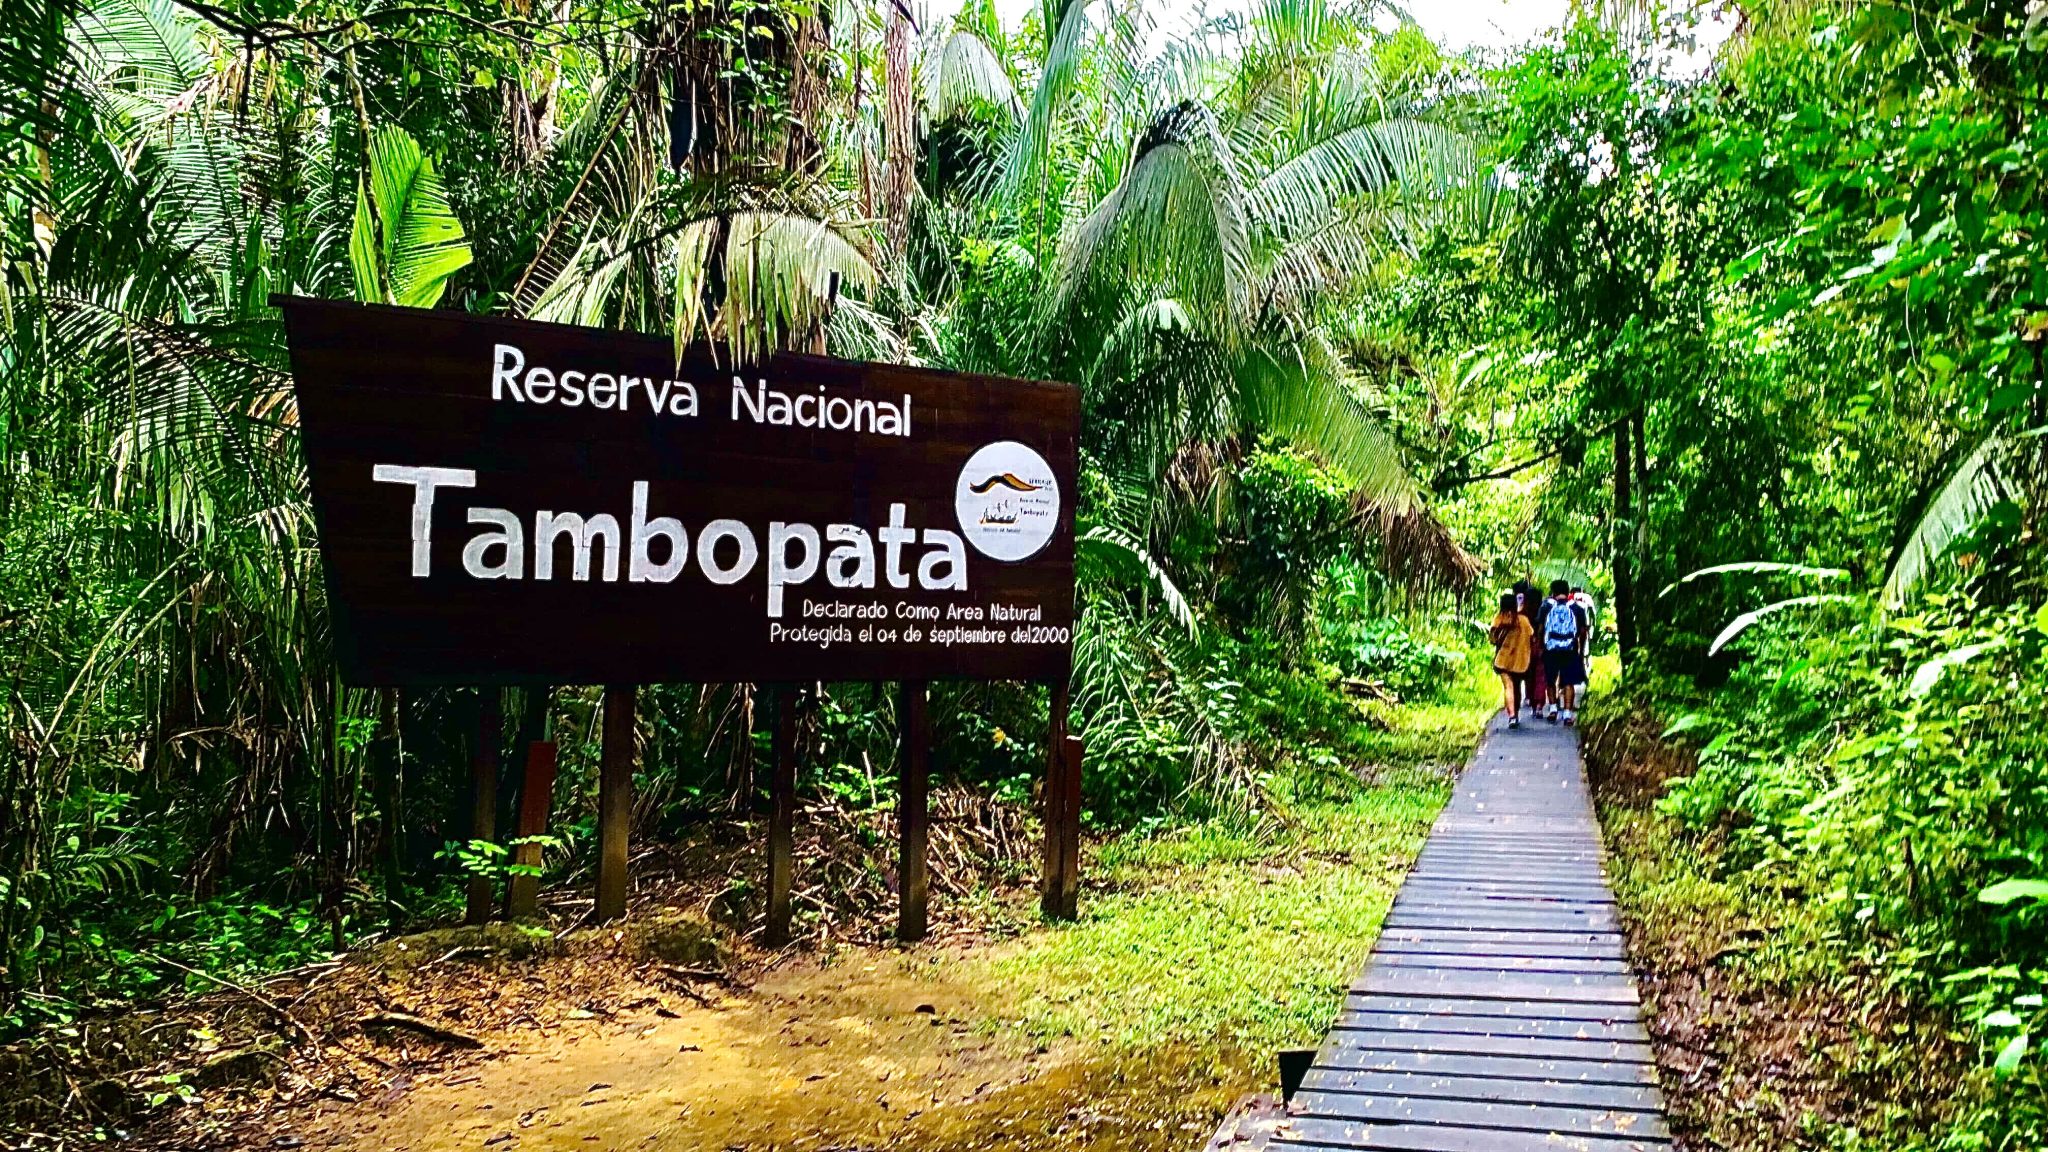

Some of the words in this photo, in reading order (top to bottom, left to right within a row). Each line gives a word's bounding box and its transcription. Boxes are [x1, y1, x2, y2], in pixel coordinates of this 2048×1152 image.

[492, 343, 698, 417] Reserva
[731, 375, 912, 437] Nacional
[372, 463, 968, 618] Tambopata
[770, 622, 852, 649] Protegida
[858, 623, 873, 643] el
[876, 628, 898, 643] 04
[903, 623, 923, 643] de
[929, 625, 1007, 648] septiembre
[802, 599, 888, 619] Declarado
[895, 600, 940, 620] Como
[946, 602, 984, 621] Area
[990, 603, 1042, 622] Natural
